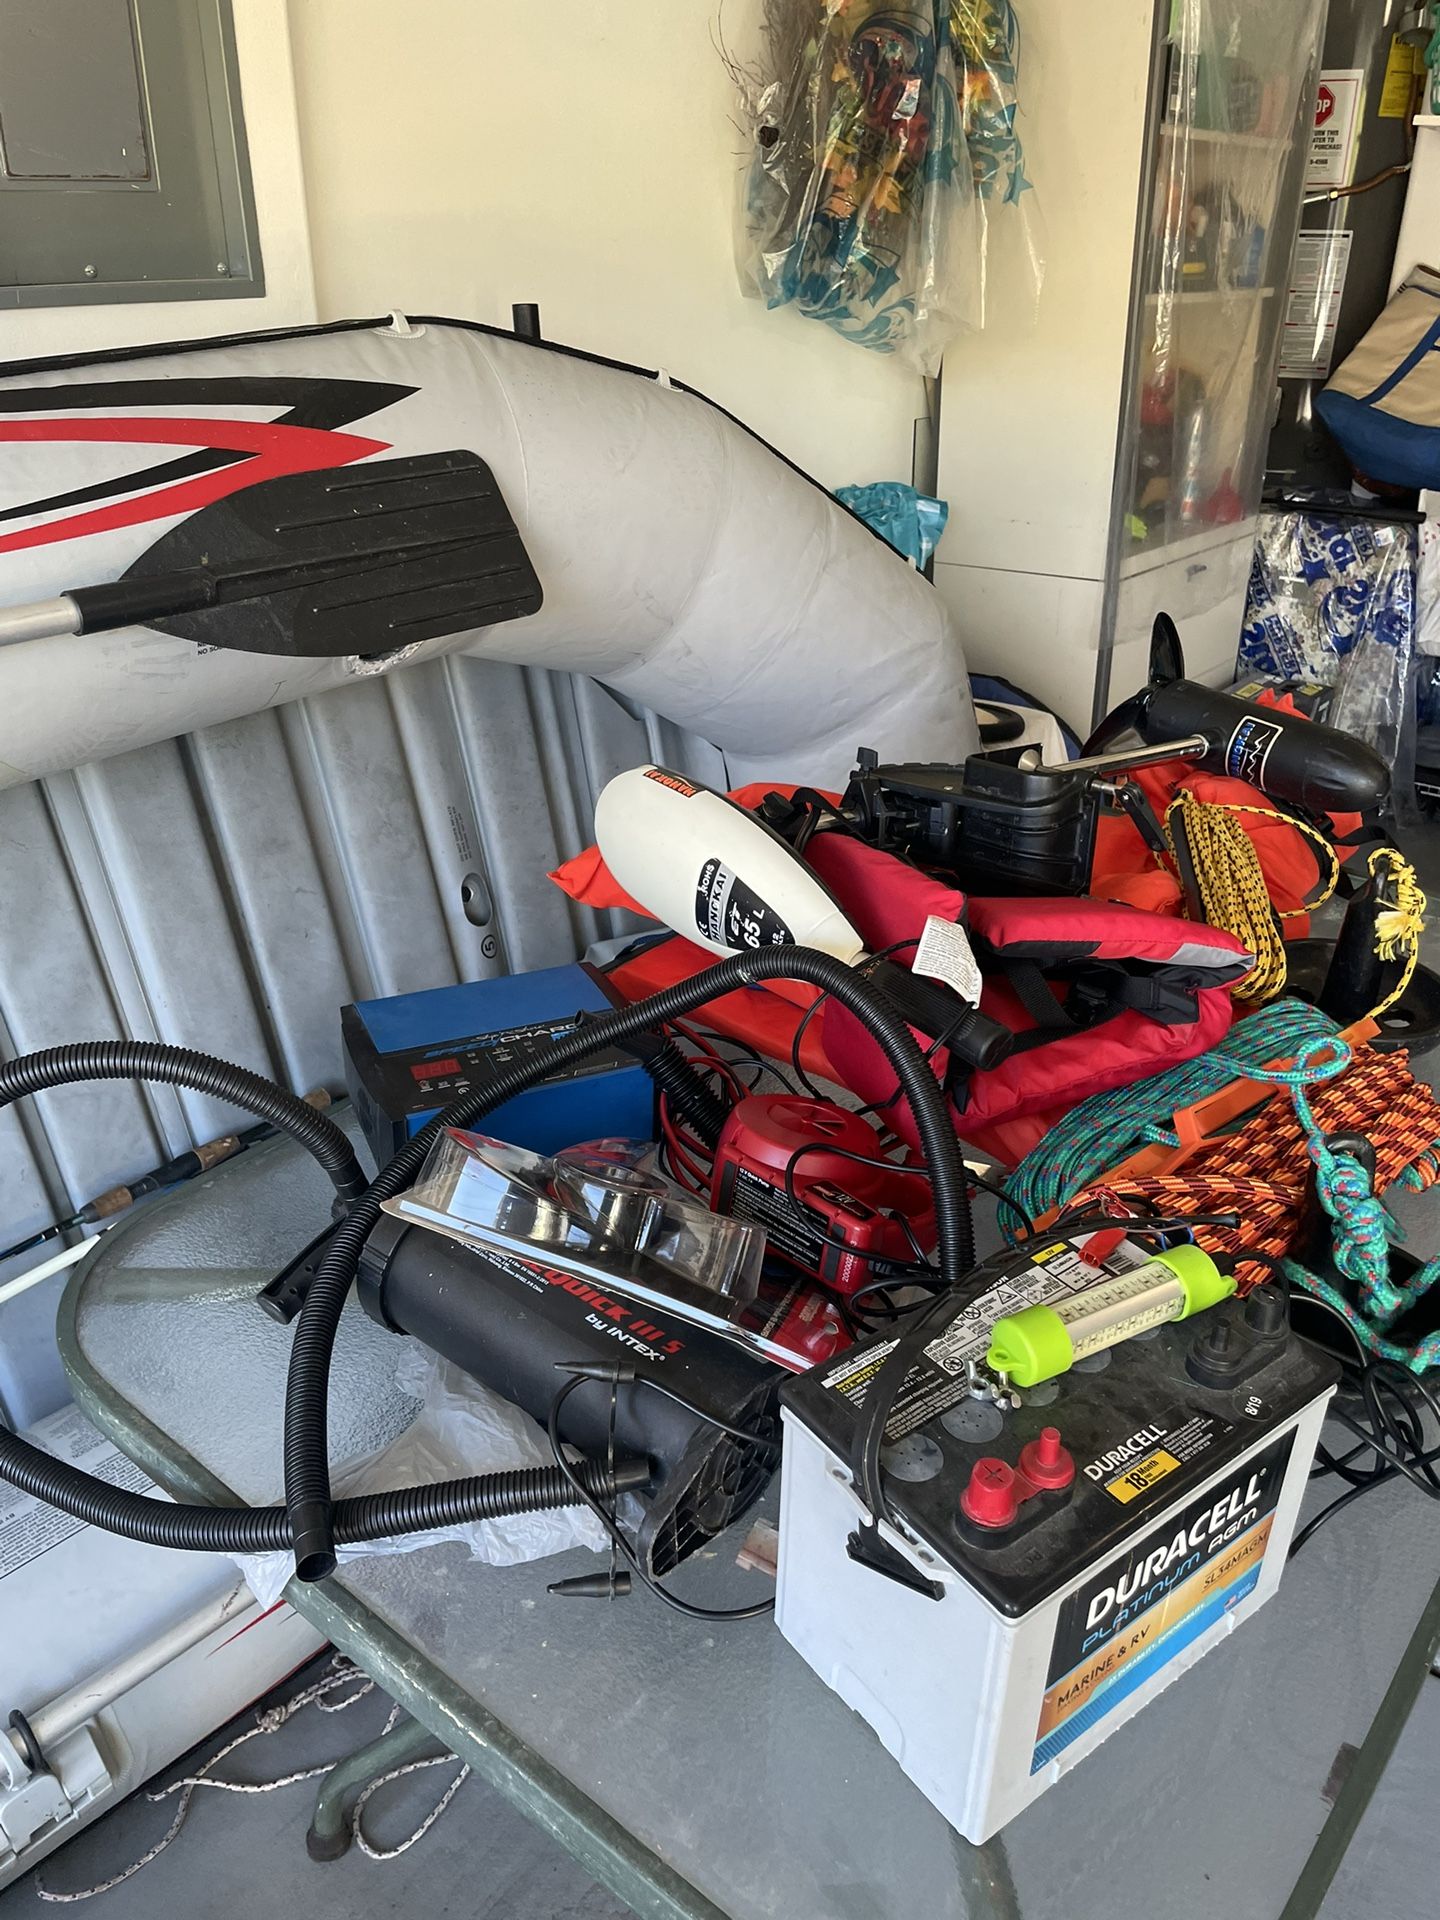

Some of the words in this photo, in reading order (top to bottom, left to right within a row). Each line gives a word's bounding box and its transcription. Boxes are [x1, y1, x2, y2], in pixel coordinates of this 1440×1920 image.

[1316, 99, 1331, 113] OP
[484, 940, 495, 952] 5
[743, 917, 760, 949] 65
[544, 1268, 633, 1322] QUICK
[585, 1313, 608, 1331] by
[607, 1327, 661, 1361] INTEX
[1244, 1396, 1262, 1416] 8/19
[1083, 1424, 1167, 1480] DURACELL
[1124, 1470, 1149, 1491] 18
[1138, 1459, 1159, 1476] Month
[1085, 1473, 1262, 1630] DURACELL
[1082, 1551, 1201, 1653] PLATINUM
[1207, 1507, 1258, 1554] AGM
[1057, 1652, 1115, 1708] MARINE
[1117, 1645, 1127, 1659] &
[1130, 1624, 1151, 1648] RV
